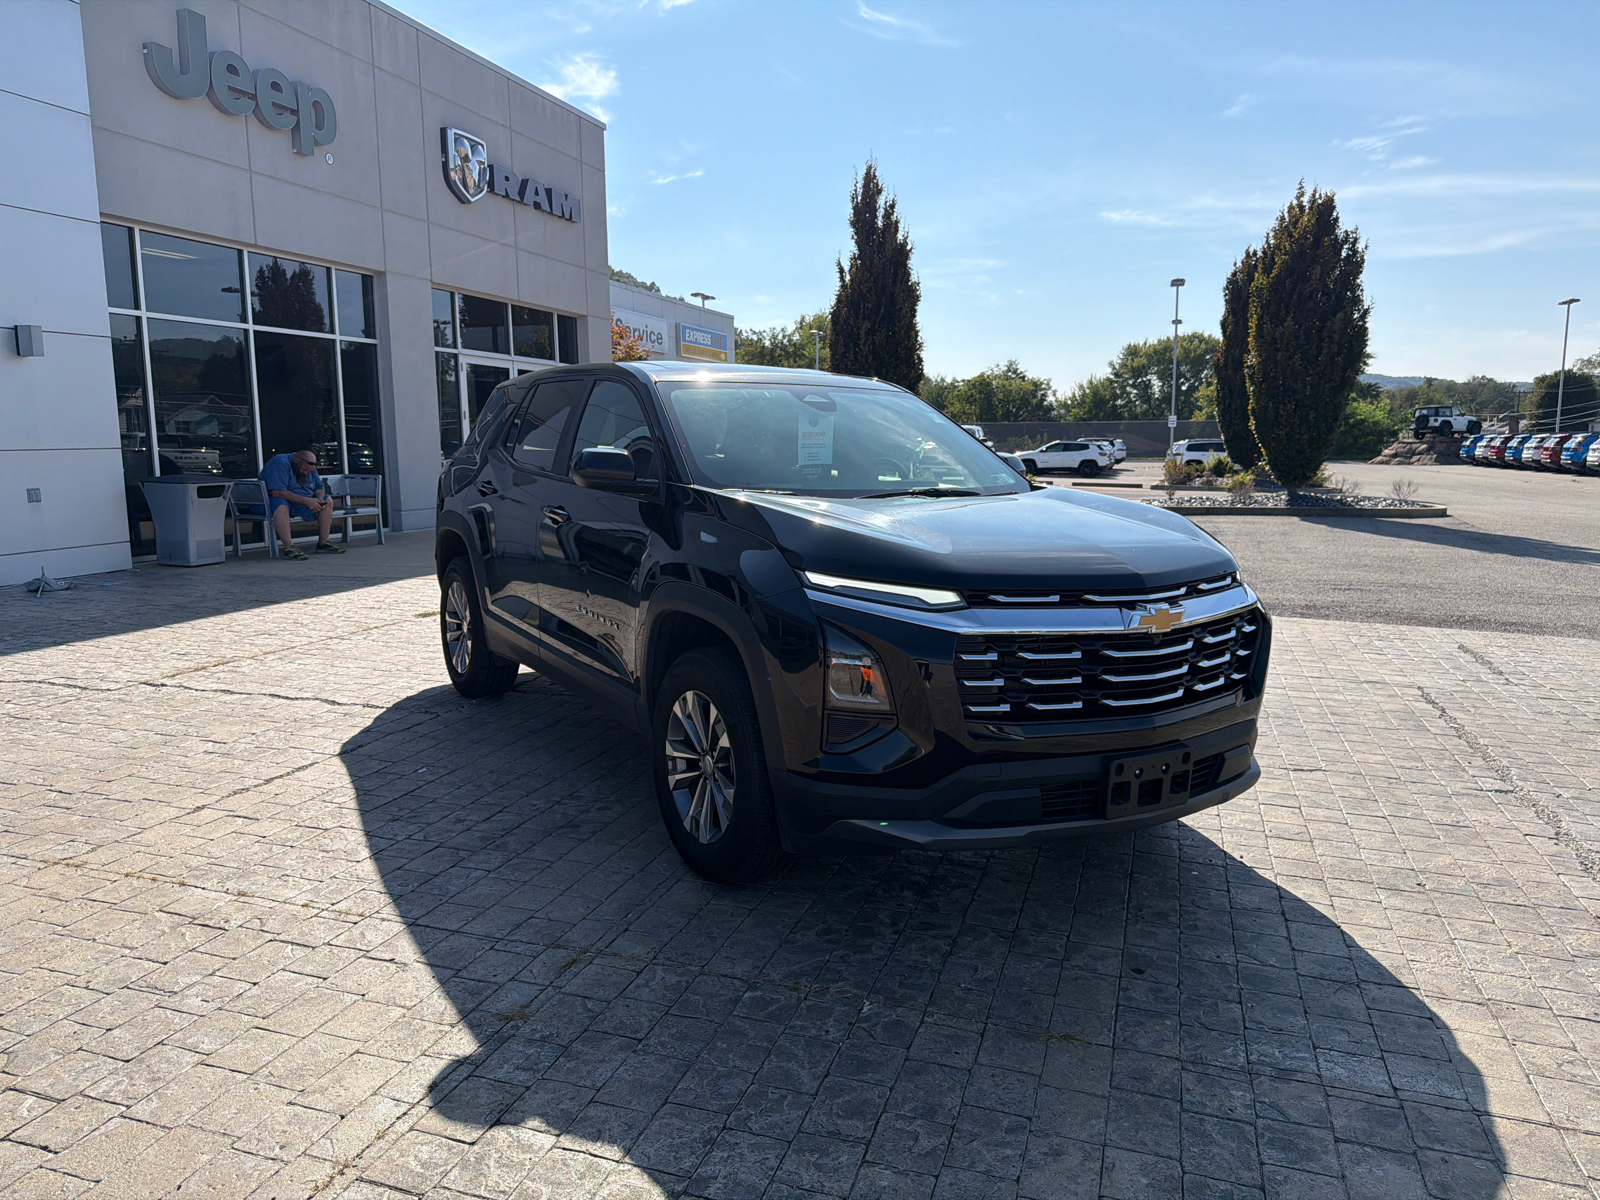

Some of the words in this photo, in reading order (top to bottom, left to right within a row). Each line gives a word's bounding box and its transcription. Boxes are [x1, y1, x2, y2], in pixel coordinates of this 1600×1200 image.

[142, 8, 337, 156] Jeep
[487, 164, 580, 223] RAM
[685, 329, 712, 346] EXPRESS
